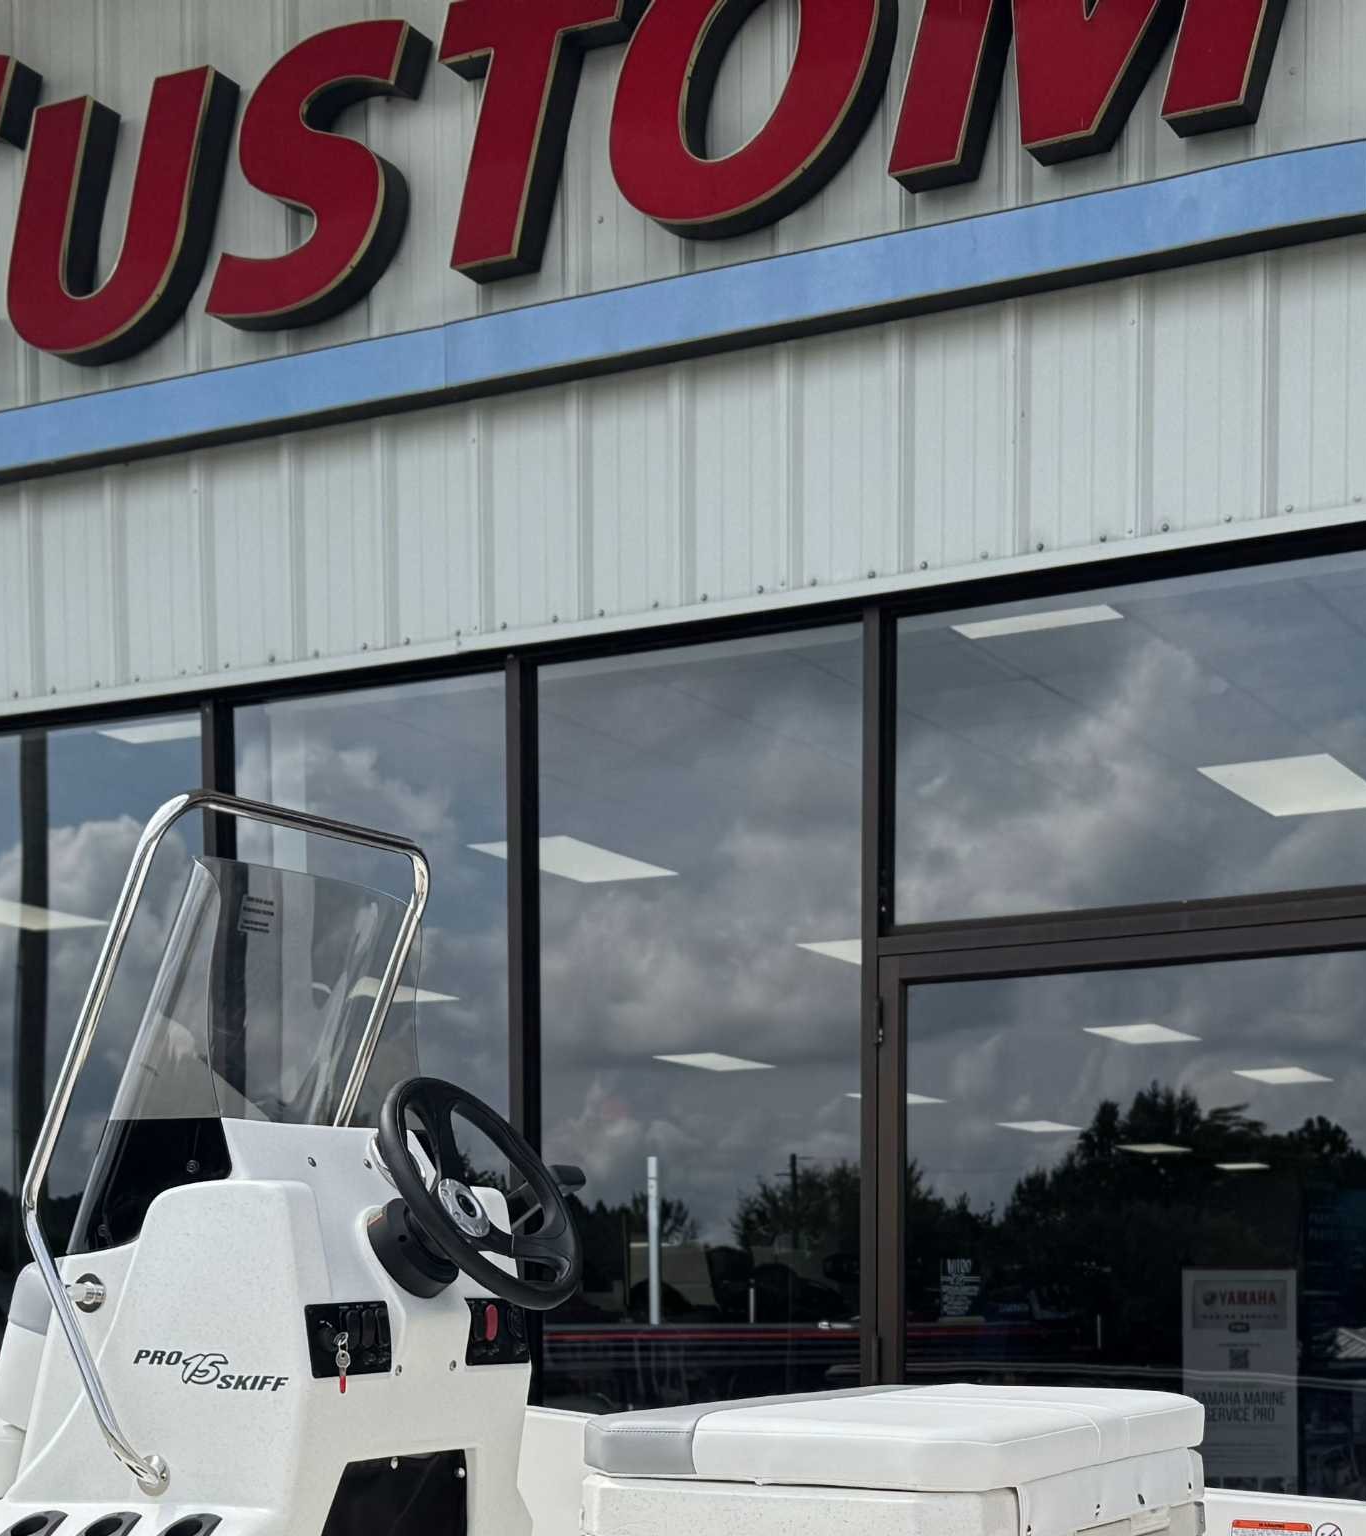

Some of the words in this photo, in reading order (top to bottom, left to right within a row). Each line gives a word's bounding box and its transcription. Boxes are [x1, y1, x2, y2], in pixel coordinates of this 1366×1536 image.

[1219, 1288, 1277, 1306] YAMAHA
[133, 1349, 183, 1366] PRO
[182, 1353, 228, 1385] 15
[216, 1374, 290, 1392] SKIFF
[1196, 1391, 1241, 1406] YAMAHA
[1243, 1391, 1287, 1406] MARINE
[1253, 1407, 1276, 1422] PRO
